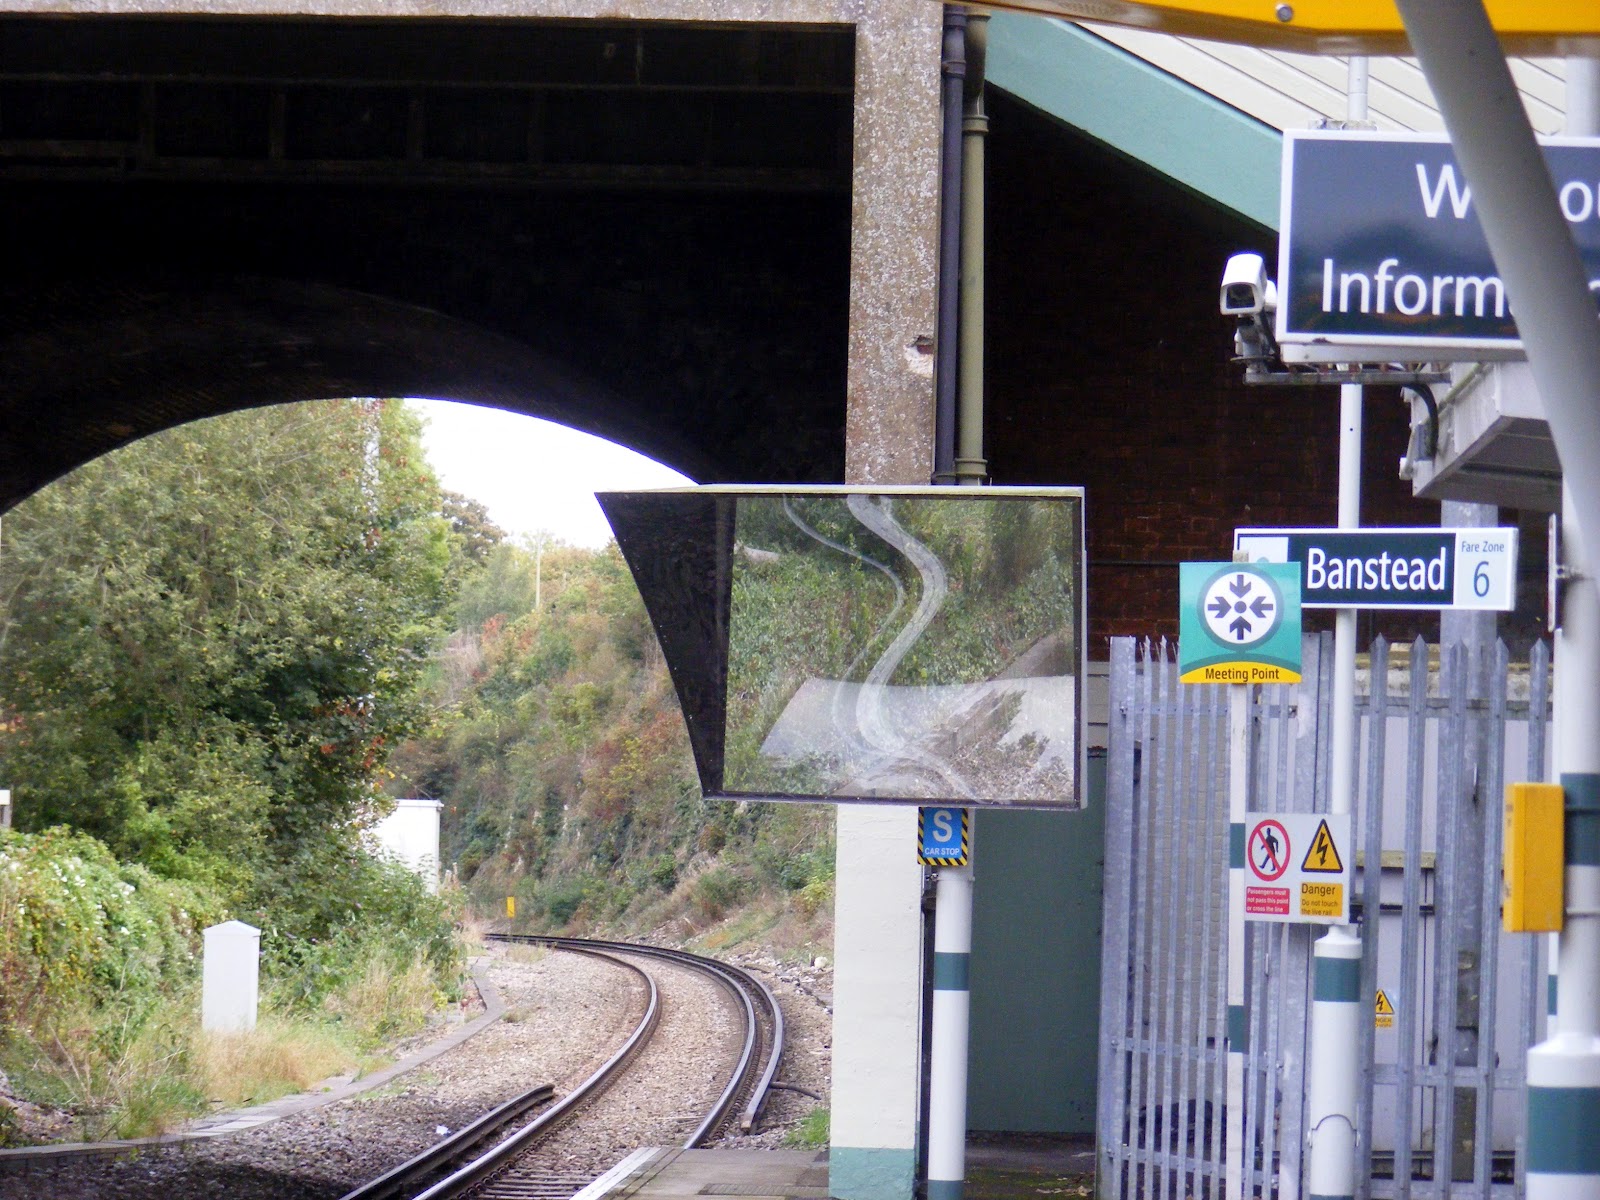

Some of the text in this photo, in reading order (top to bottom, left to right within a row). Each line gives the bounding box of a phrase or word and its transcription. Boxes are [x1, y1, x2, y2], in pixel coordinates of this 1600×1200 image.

[1322, 257, 1600, 318] Inform
[1461, 540, 1505, 552] Fare Zone
[1306, 546, 1447, 591] Banstead
[1473, 560, 1490, 598] 6
[1205, 668, 1279, 682] Meeting Point
[932, 809, 953, 843] S
[924, 847, 960, 856] CAR STOP
[1301, 883, 1335, 897] Danger
[1301, 898, 1310, 906] Do
[1311, 899, 1321, 907] not
